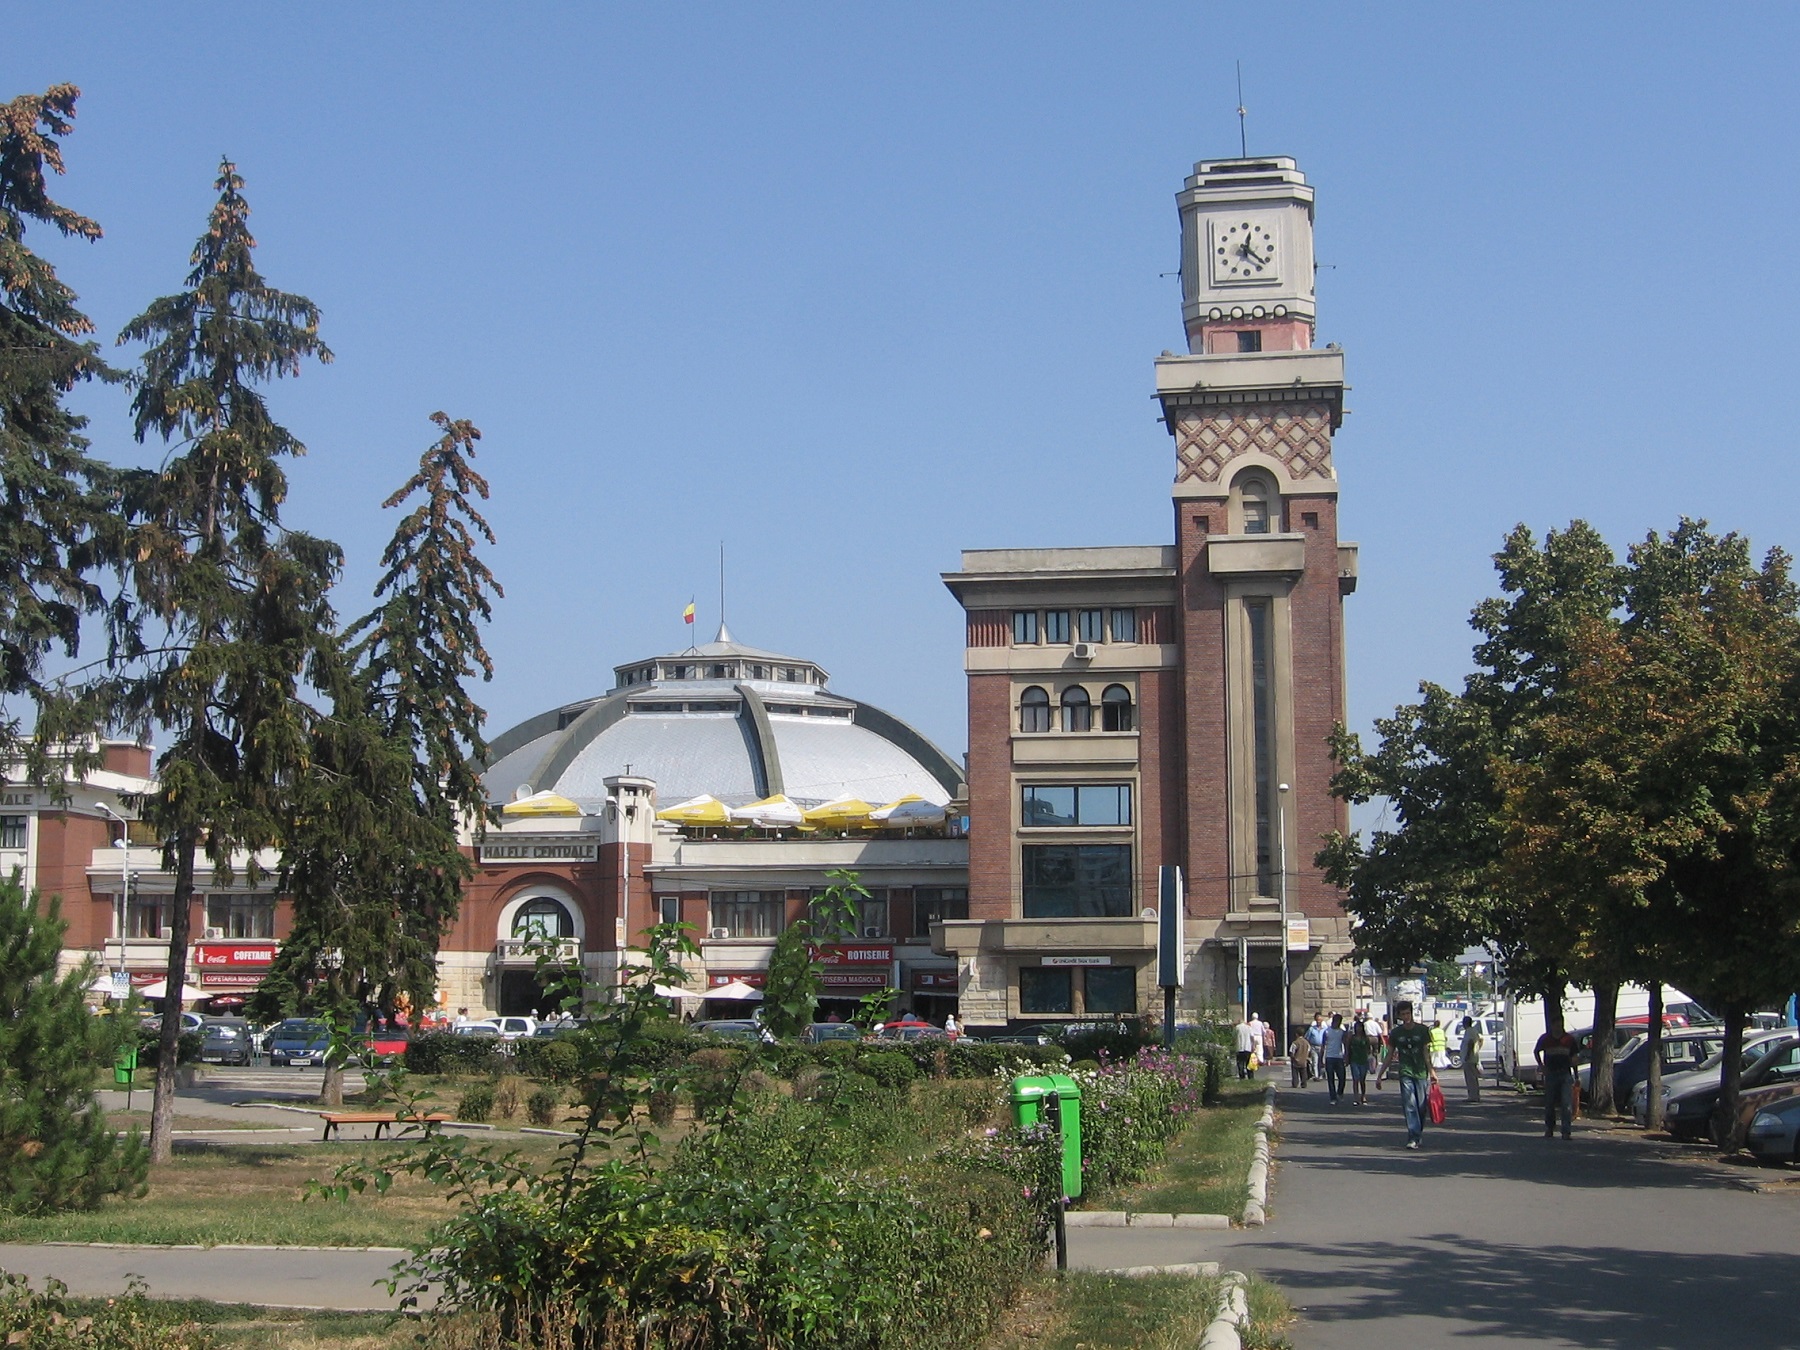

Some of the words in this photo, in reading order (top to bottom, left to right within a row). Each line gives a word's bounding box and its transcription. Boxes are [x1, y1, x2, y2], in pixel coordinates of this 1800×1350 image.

[0, 794, 32, 805] ALE
[484, 846, 528, 858] HALELE
[533, 846, 594, 858] CENTRALE
[233, 951, 272, 960] COFETARIE
[847, 950, 889, 959] ROTISERIE
